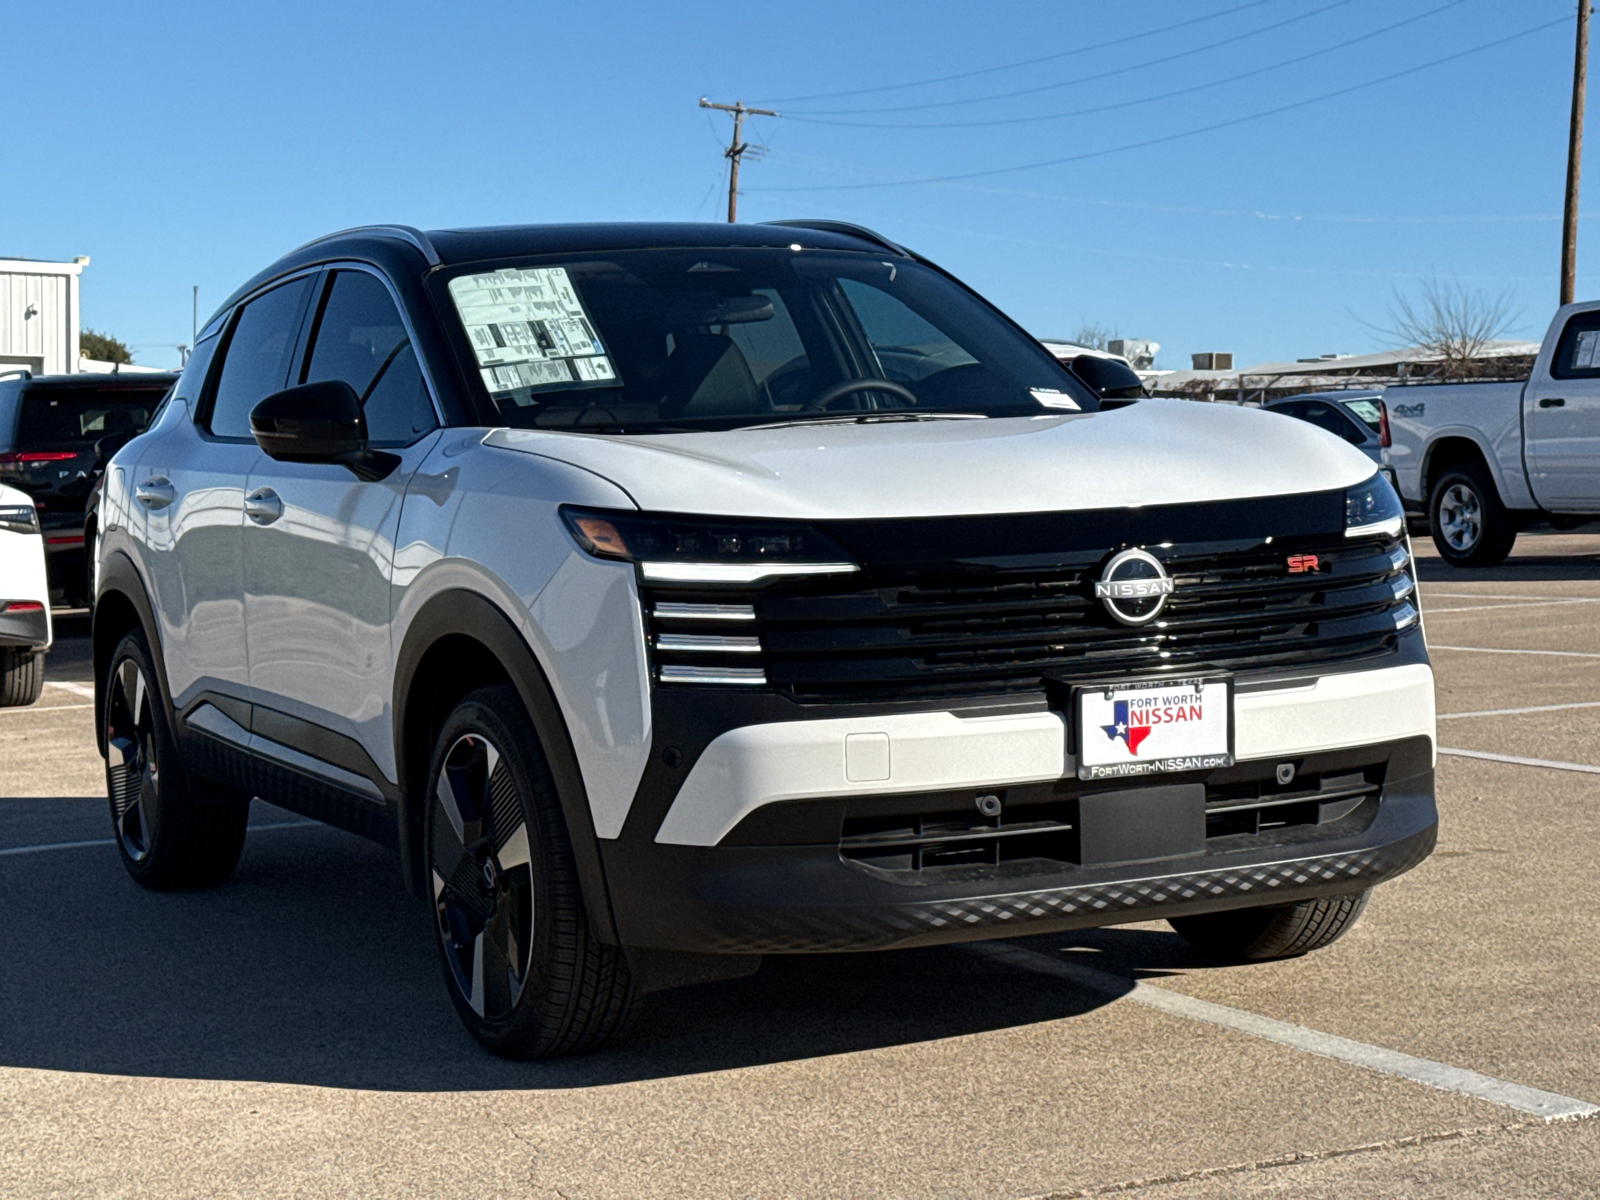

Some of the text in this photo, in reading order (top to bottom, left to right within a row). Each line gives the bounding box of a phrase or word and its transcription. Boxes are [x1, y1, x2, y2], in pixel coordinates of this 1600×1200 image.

[1287, 554, 1320, 573] SR
[1096, 580, 1174, 596] NISSAN
[1108, 678, 1204, 691] FORT WORTH TEXAS
[1130, 694, 1203, 709] FORT WORTH
[1130, 704, 1203, 726] NISSAN
